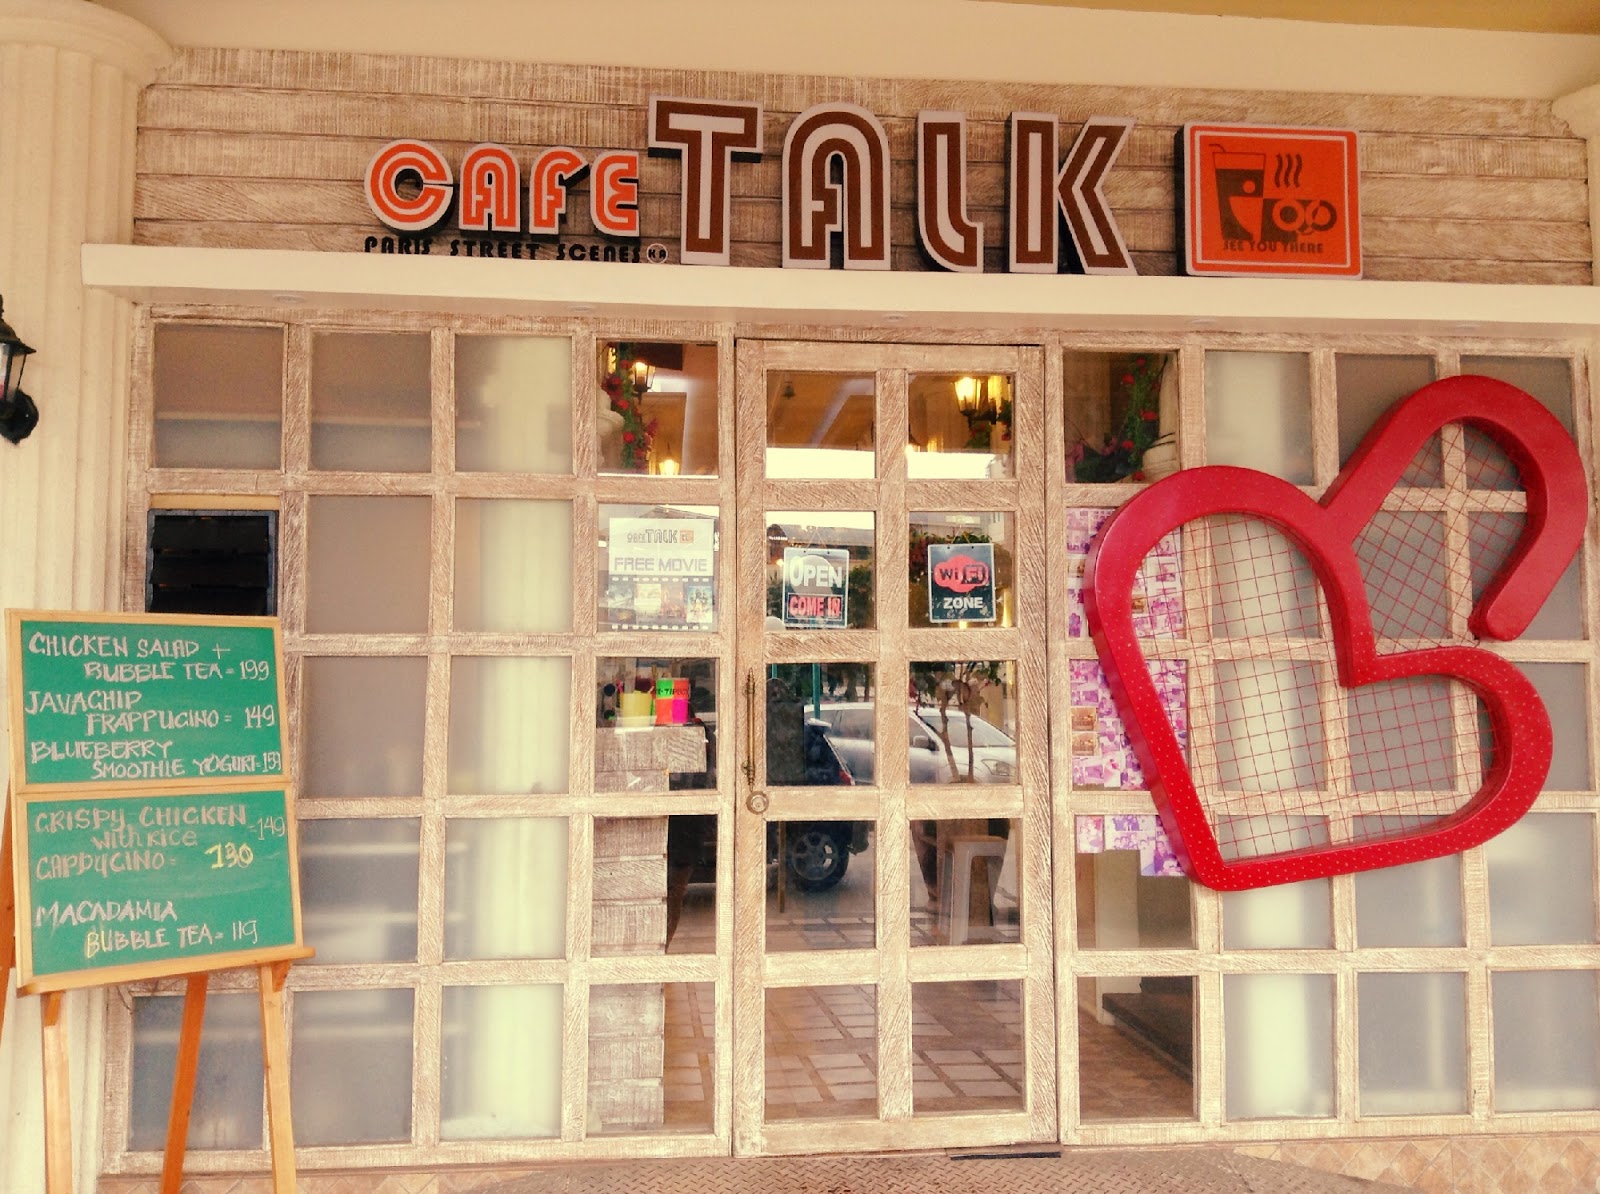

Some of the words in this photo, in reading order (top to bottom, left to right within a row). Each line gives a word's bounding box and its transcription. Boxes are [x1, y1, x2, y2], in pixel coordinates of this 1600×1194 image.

[364, 139, 640, 239] CAFE
[648, 95, 1137, 276] TALK
[364, 236, 432, 255] PARIS
[450, 239, 541, 261] STREET
[556, 243, 641, 263] SCENES
[1224, 239, 1245, 252] SEE
[1250, 240, 1277, 252] YOU
[1282, 241, 1324, 254] THERE
[614, 557, 654, 571] FREE
[658, 558, 708, 572] MOVIE
[789, 556, 843, 588] OPEN
[789, 595, 824, 617] COME
[827, 596, 841, 617] IN
[943, 597, 984, 609] ZONE
[29, 632, 129, 657] CHICKEN
[136, 639, 200, 659] SALAD
[83, 661, 176, 683] BUBBLE
[182, 662, 223, 680] TEA
[239, 659, 270, 681] 199
[25, 690, 143, 715] JAVACHIP
[86, 708, 220, 736] FRAPPUCINO
[243, 704, 276, 729] 149
[31, 740, 173, 763] BLUEBERRY
[91, 759, 186, 780] SMOOTHIE
[34, 807, 125, 833] CRISPY
[138, 804, 247, 827] CHICKEN
[257, 816, 286, 841] 149
[35, 850, 165, 880] CAPPUCINO
[35, 899, 178, 928] MACADAMIA
[84, 928, 169, 959] BUBBLE
[177, 923, 214, 949] TEA
[232, 919, 258, 944] 119
